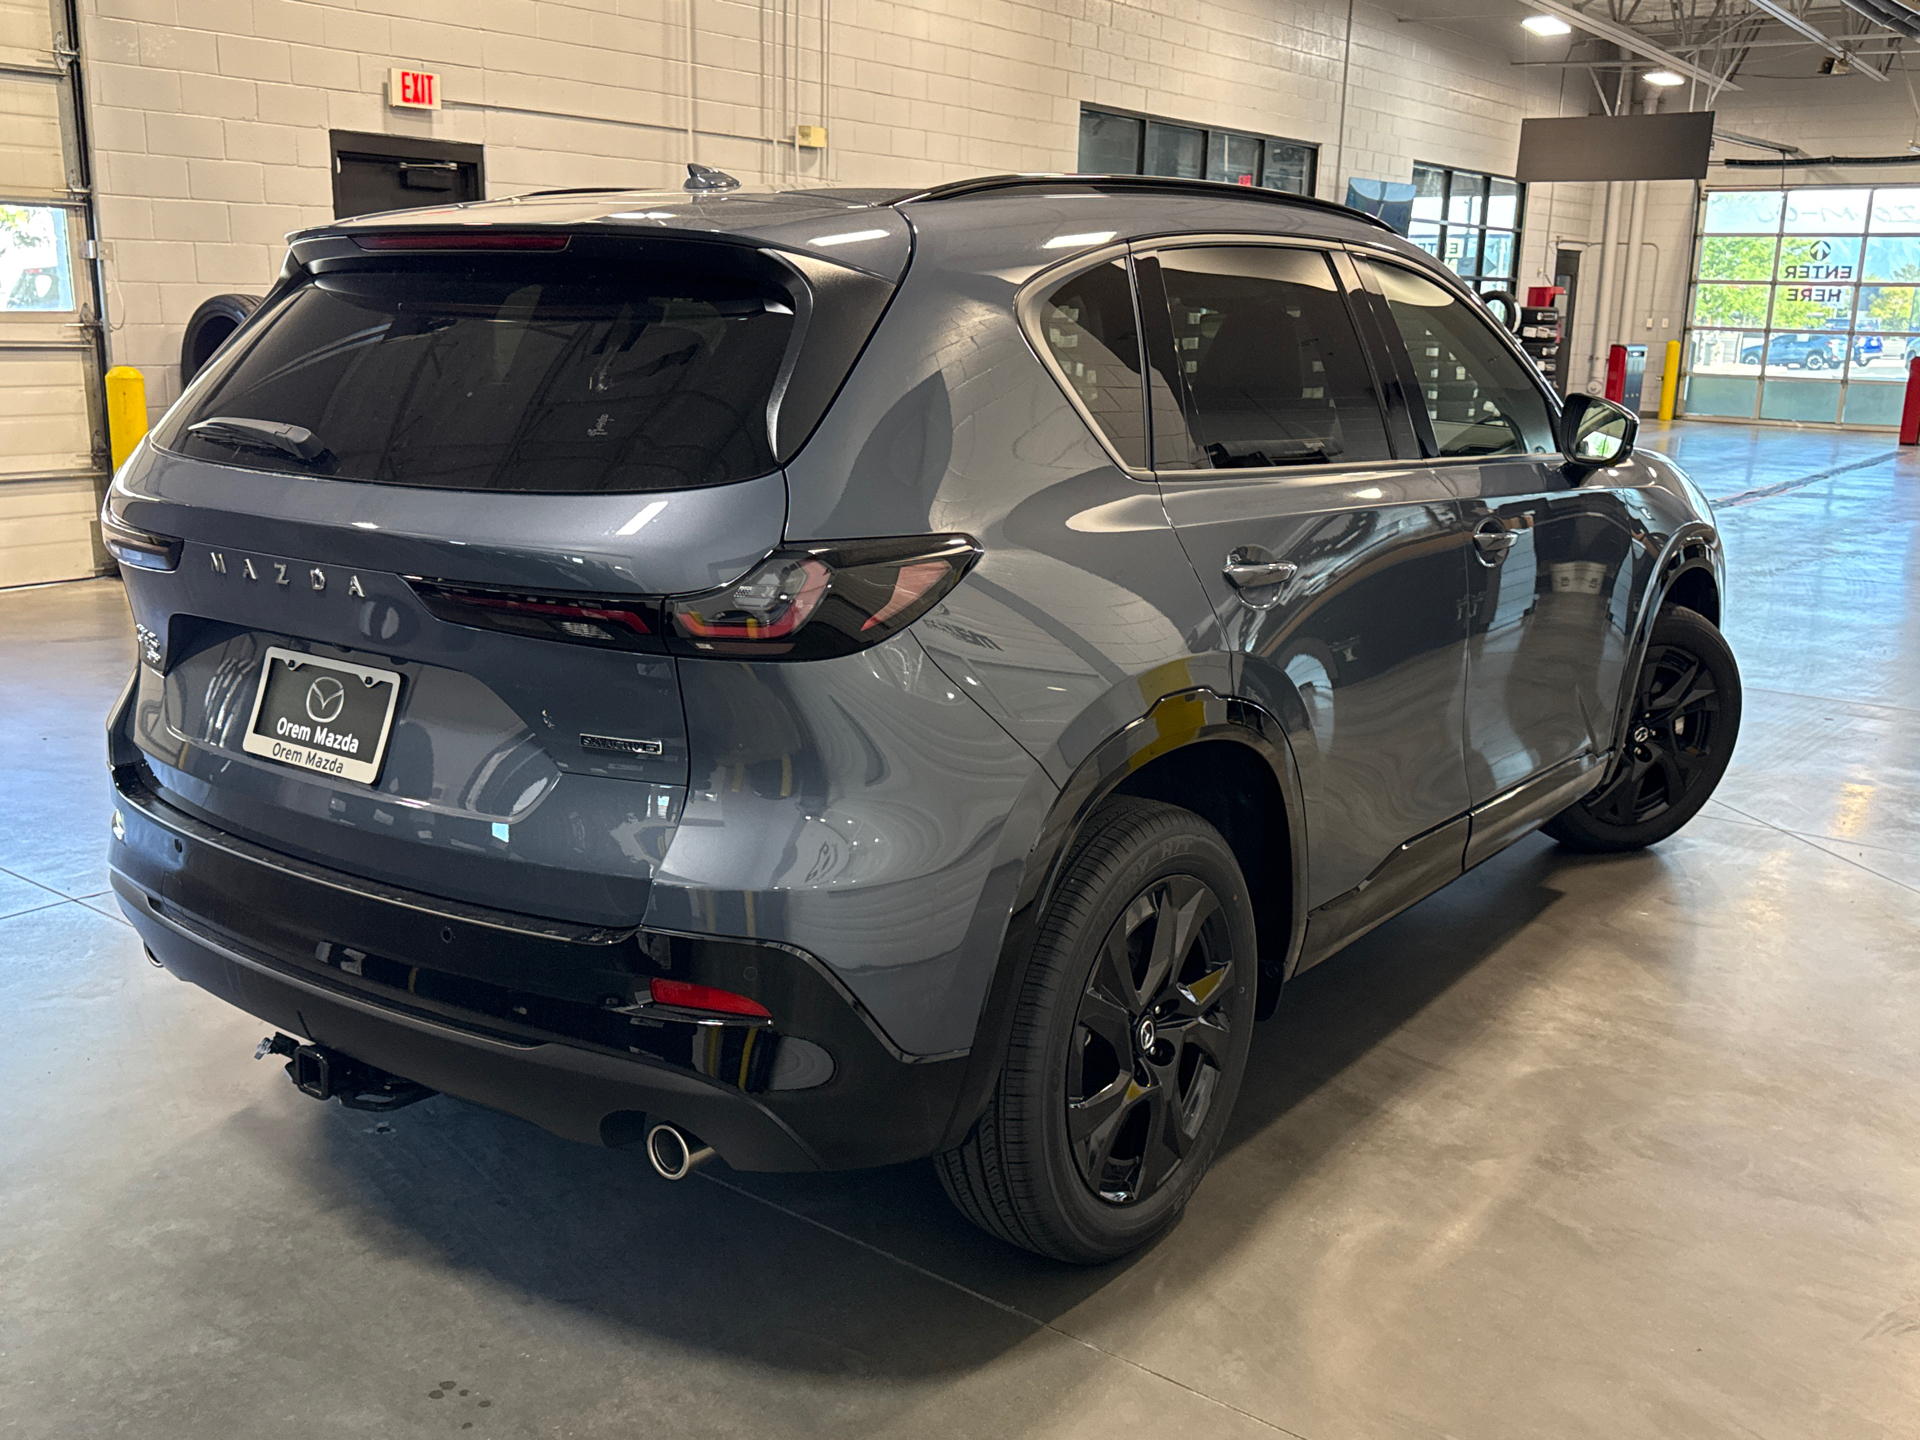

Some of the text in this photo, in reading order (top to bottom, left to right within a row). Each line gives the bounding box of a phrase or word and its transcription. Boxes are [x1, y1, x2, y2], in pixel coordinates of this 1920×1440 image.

[401, 71, 434, 106] EXIT
[210, 552, 366, 598] MAZDA
[276, 717, 360, 754] Orem Mazda
[272, 742, 344, 774] Orem Mazda
